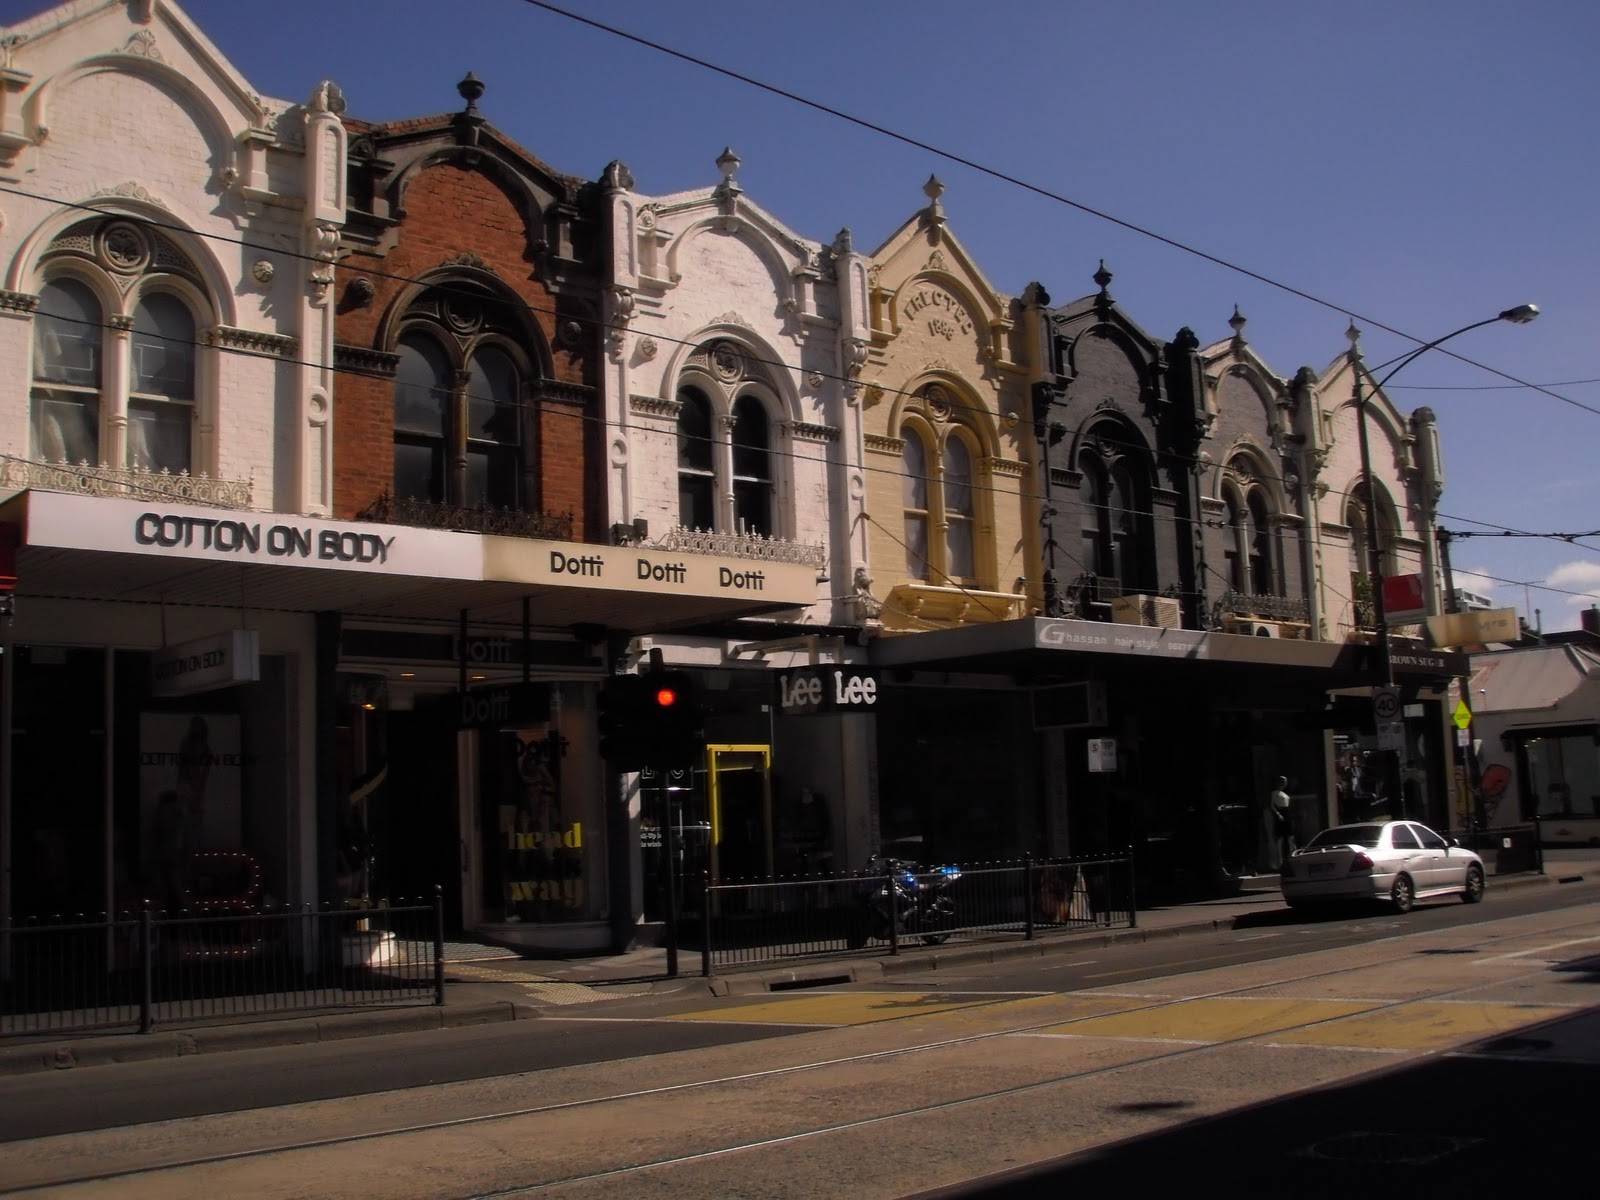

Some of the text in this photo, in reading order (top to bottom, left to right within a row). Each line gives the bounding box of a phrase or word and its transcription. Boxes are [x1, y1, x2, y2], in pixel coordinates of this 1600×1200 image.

[904, 290, 972, 336] ERECTED
[135, 512, 396, 564] COTTON ON BODY
[550, 550, 765, 591] Dotti Dotti Dotti
[1039, 623, 1107, 645] Ghassan
[1115, 636, 1134, 647] hair
[1418, 657, 1444, 668] SUGR
[780, 671, 877, 708] Lee Lee
[1377, 698, 1395, 711] 40
[140, 752, 194, 766] COTT
[510, 879, 584, 909] way
